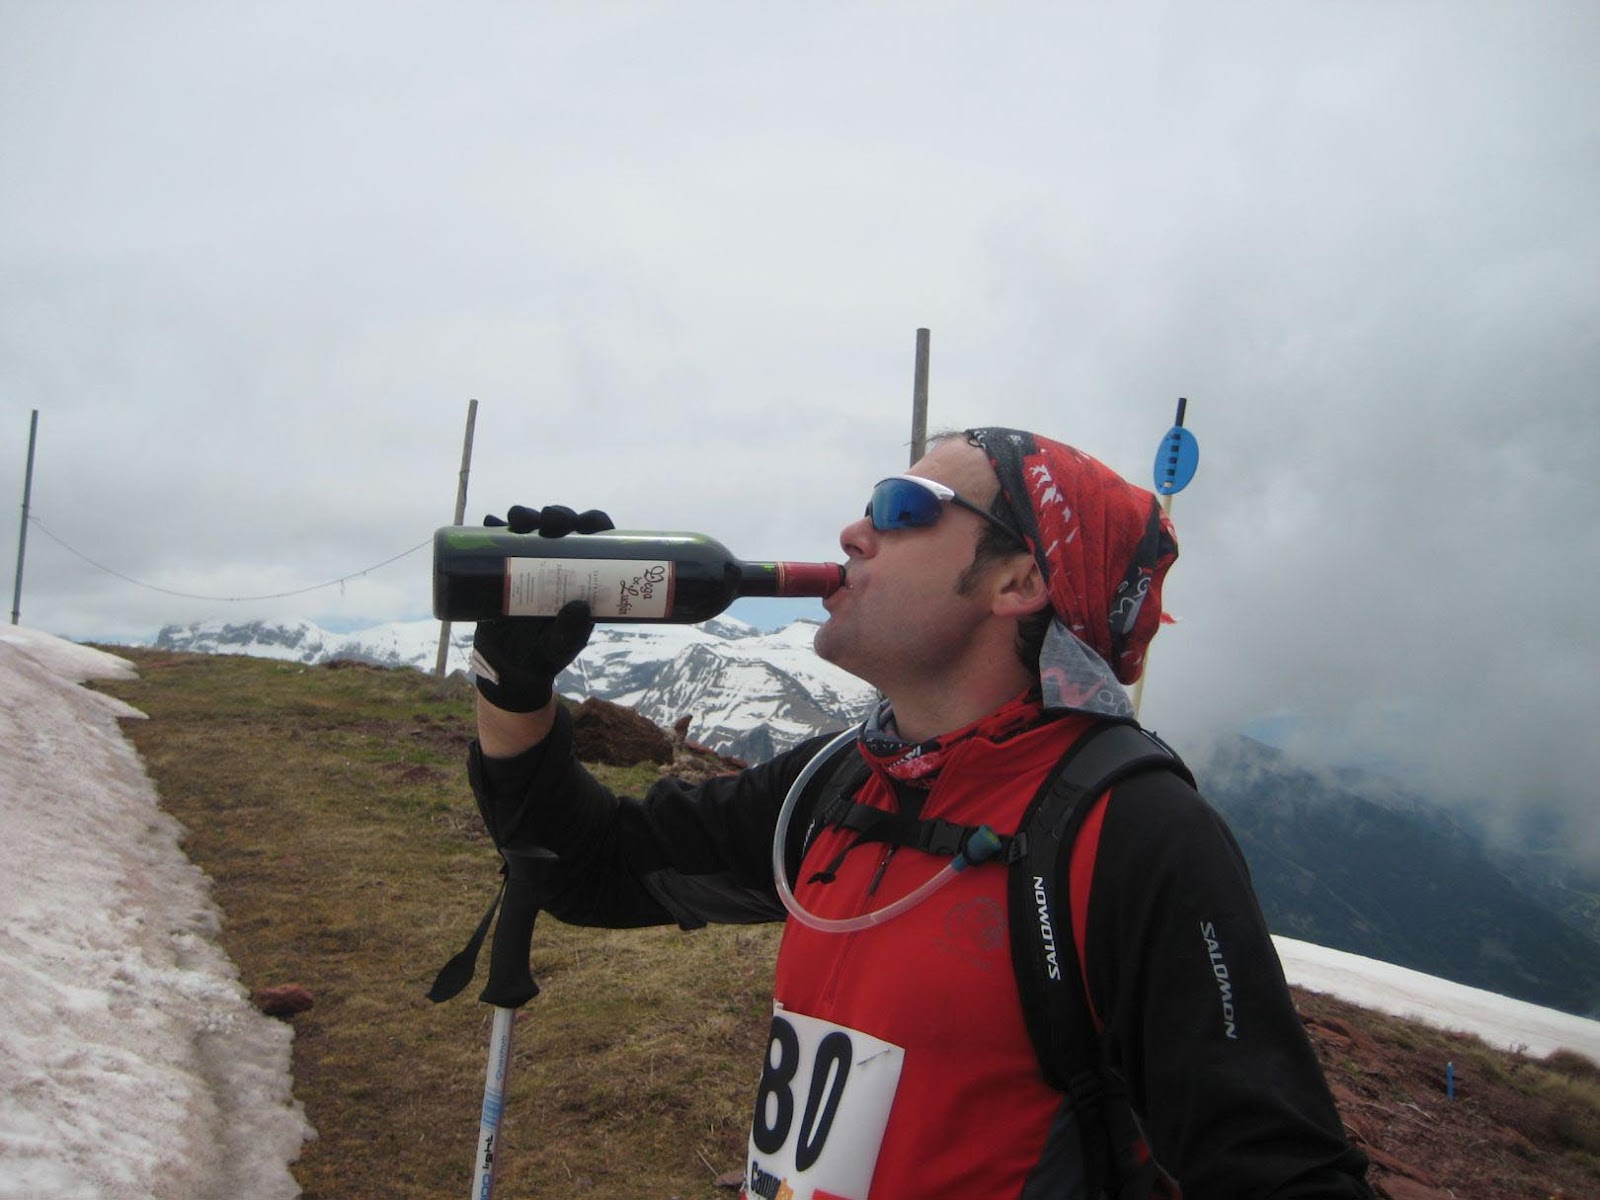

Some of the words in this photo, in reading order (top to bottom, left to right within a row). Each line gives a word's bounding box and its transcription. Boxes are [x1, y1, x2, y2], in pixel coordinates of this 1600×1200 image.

[1033, 876, 1060, 981] SALOMON
[1200, 921, 1237, 1039] SALOMON
[753, 1016, 853, 1172] 80
[482, 1135, 494, 1170] light
